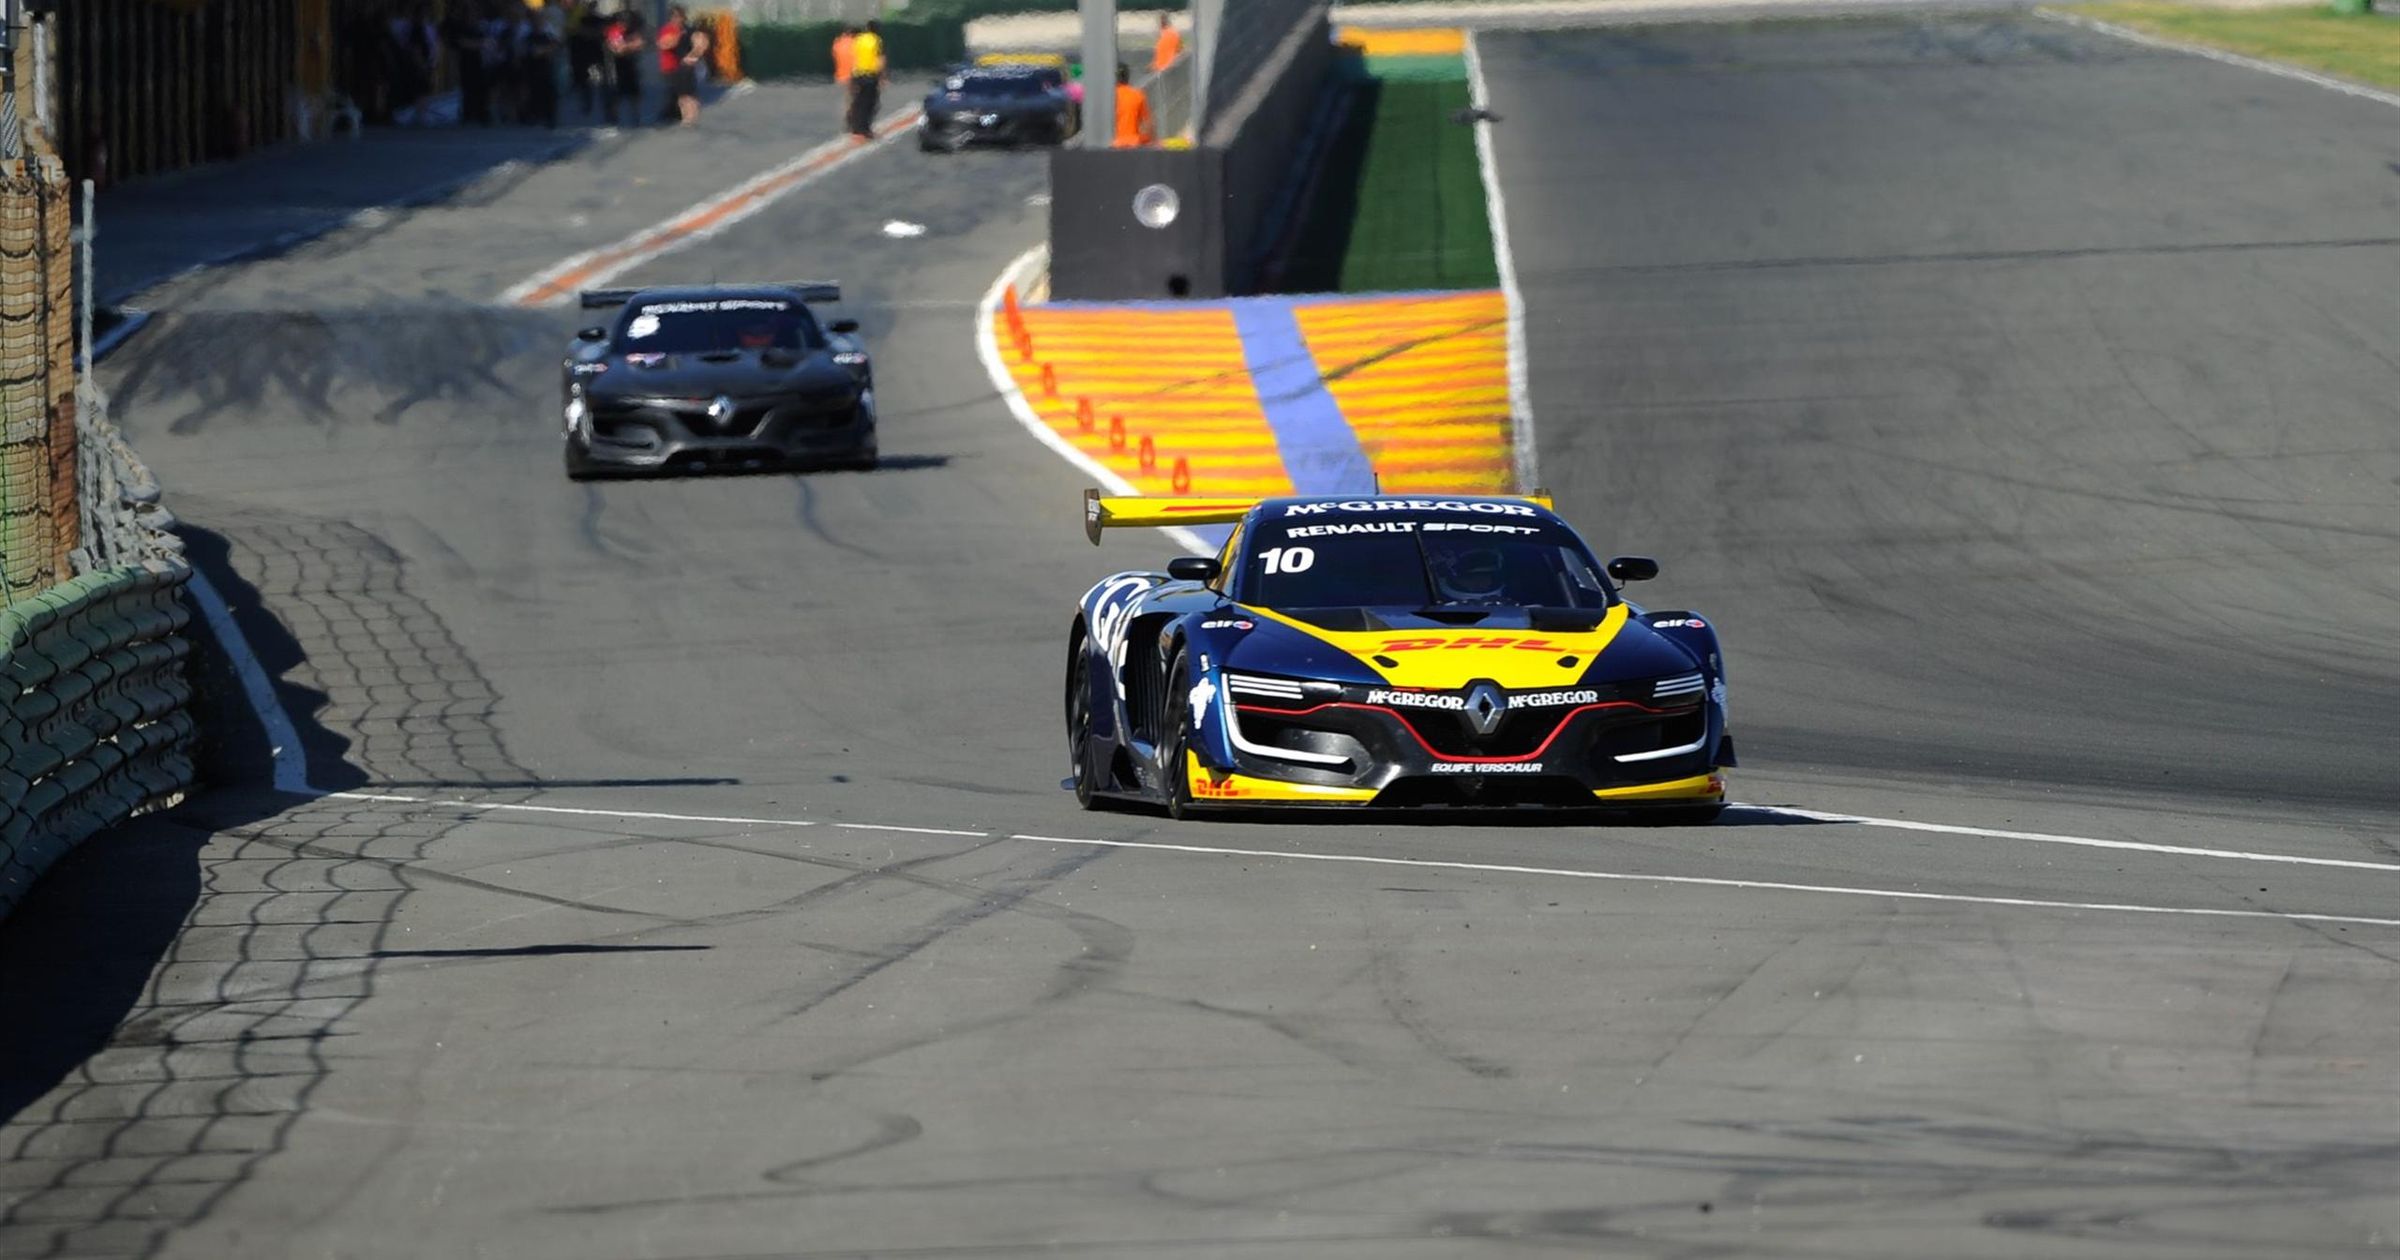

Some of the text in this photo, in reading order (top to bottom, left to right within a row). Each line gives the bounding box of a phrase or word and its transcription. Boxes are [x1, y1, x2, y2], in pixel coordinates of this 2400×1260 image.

[1286, 522, 1540, 538] RENAULT SPORT
[1258, 547, 1315, 575] 10
[1201, 620, 1234, 629] elf
[1653, 619, 1686, 628] elf
[1380, 637, 1566, 652] DHL
[1432, 762, 1542, 772] EQUIPE VERSCHUUR
[1196, 778, 1239, 797] DHL
